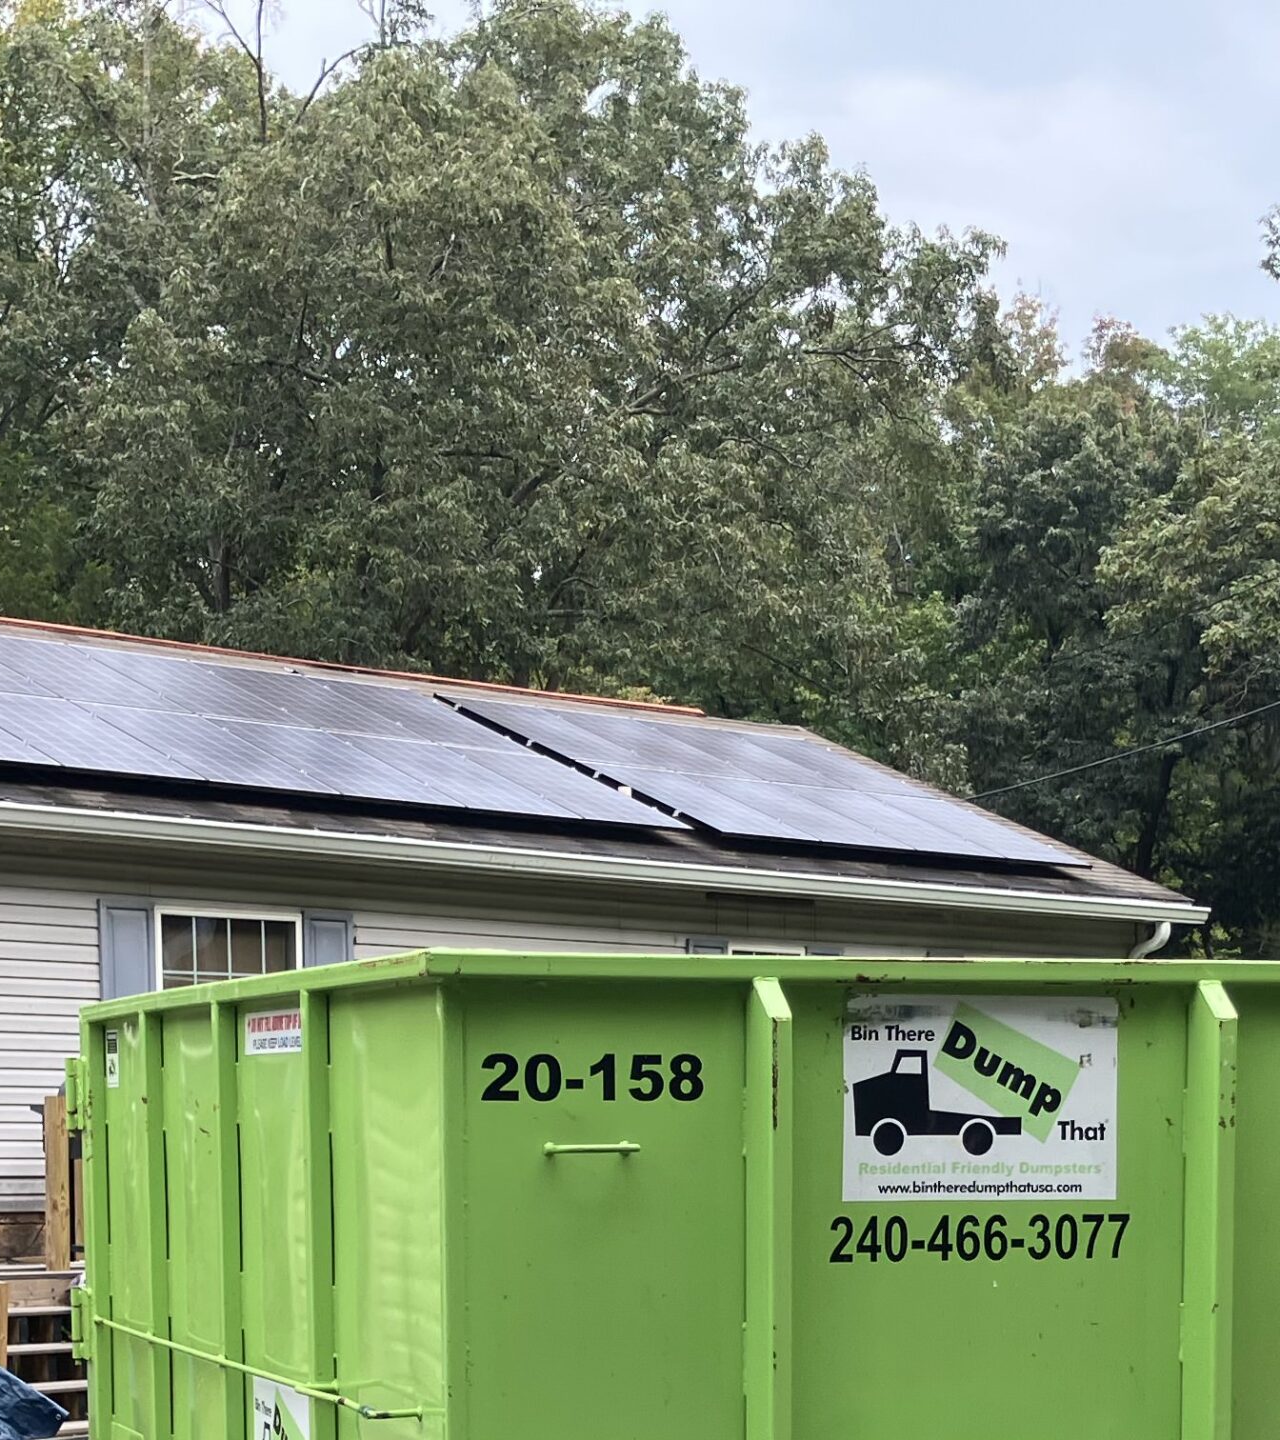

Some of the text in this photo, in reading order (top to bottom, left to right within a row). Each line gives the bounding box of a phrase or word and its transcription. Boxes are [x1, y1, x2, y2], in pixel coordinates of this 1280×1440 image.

[851, 1025, 935, 1042] Bin There
[480, 1053, 704, 1102] 20-158
[941, 1019, 1062, 1118] Dump
[1057, 1119, 1106, 1141] That
[858, 1161, 1102, 1178] Residential Friendly Dumpsters
[877, 1180, 1083, 1197] www.bintheredumpthatusa.com
[829, 1213, 1130, 1264] 240-466-3077
